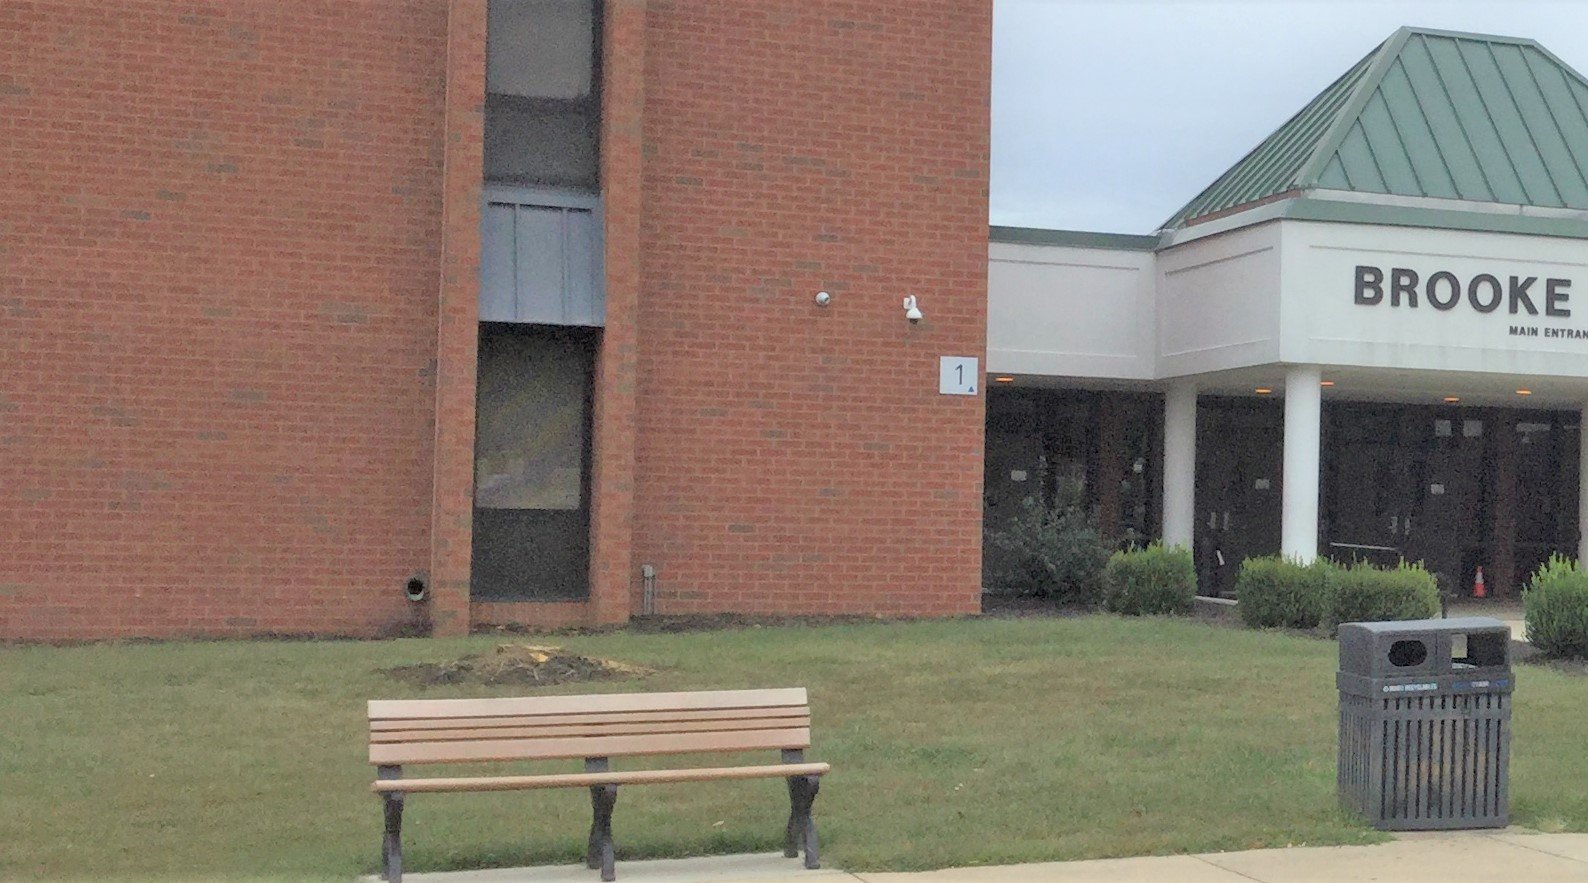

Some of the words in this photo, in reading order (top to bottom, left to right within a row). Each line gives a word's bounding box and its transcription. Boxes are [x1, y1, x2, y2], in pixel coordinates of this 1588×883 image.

[1354, 265, 1572, 318] BROOKE
[1508, 325, 1539, 337] MAIN
[955, 363, 963, 385] 1
